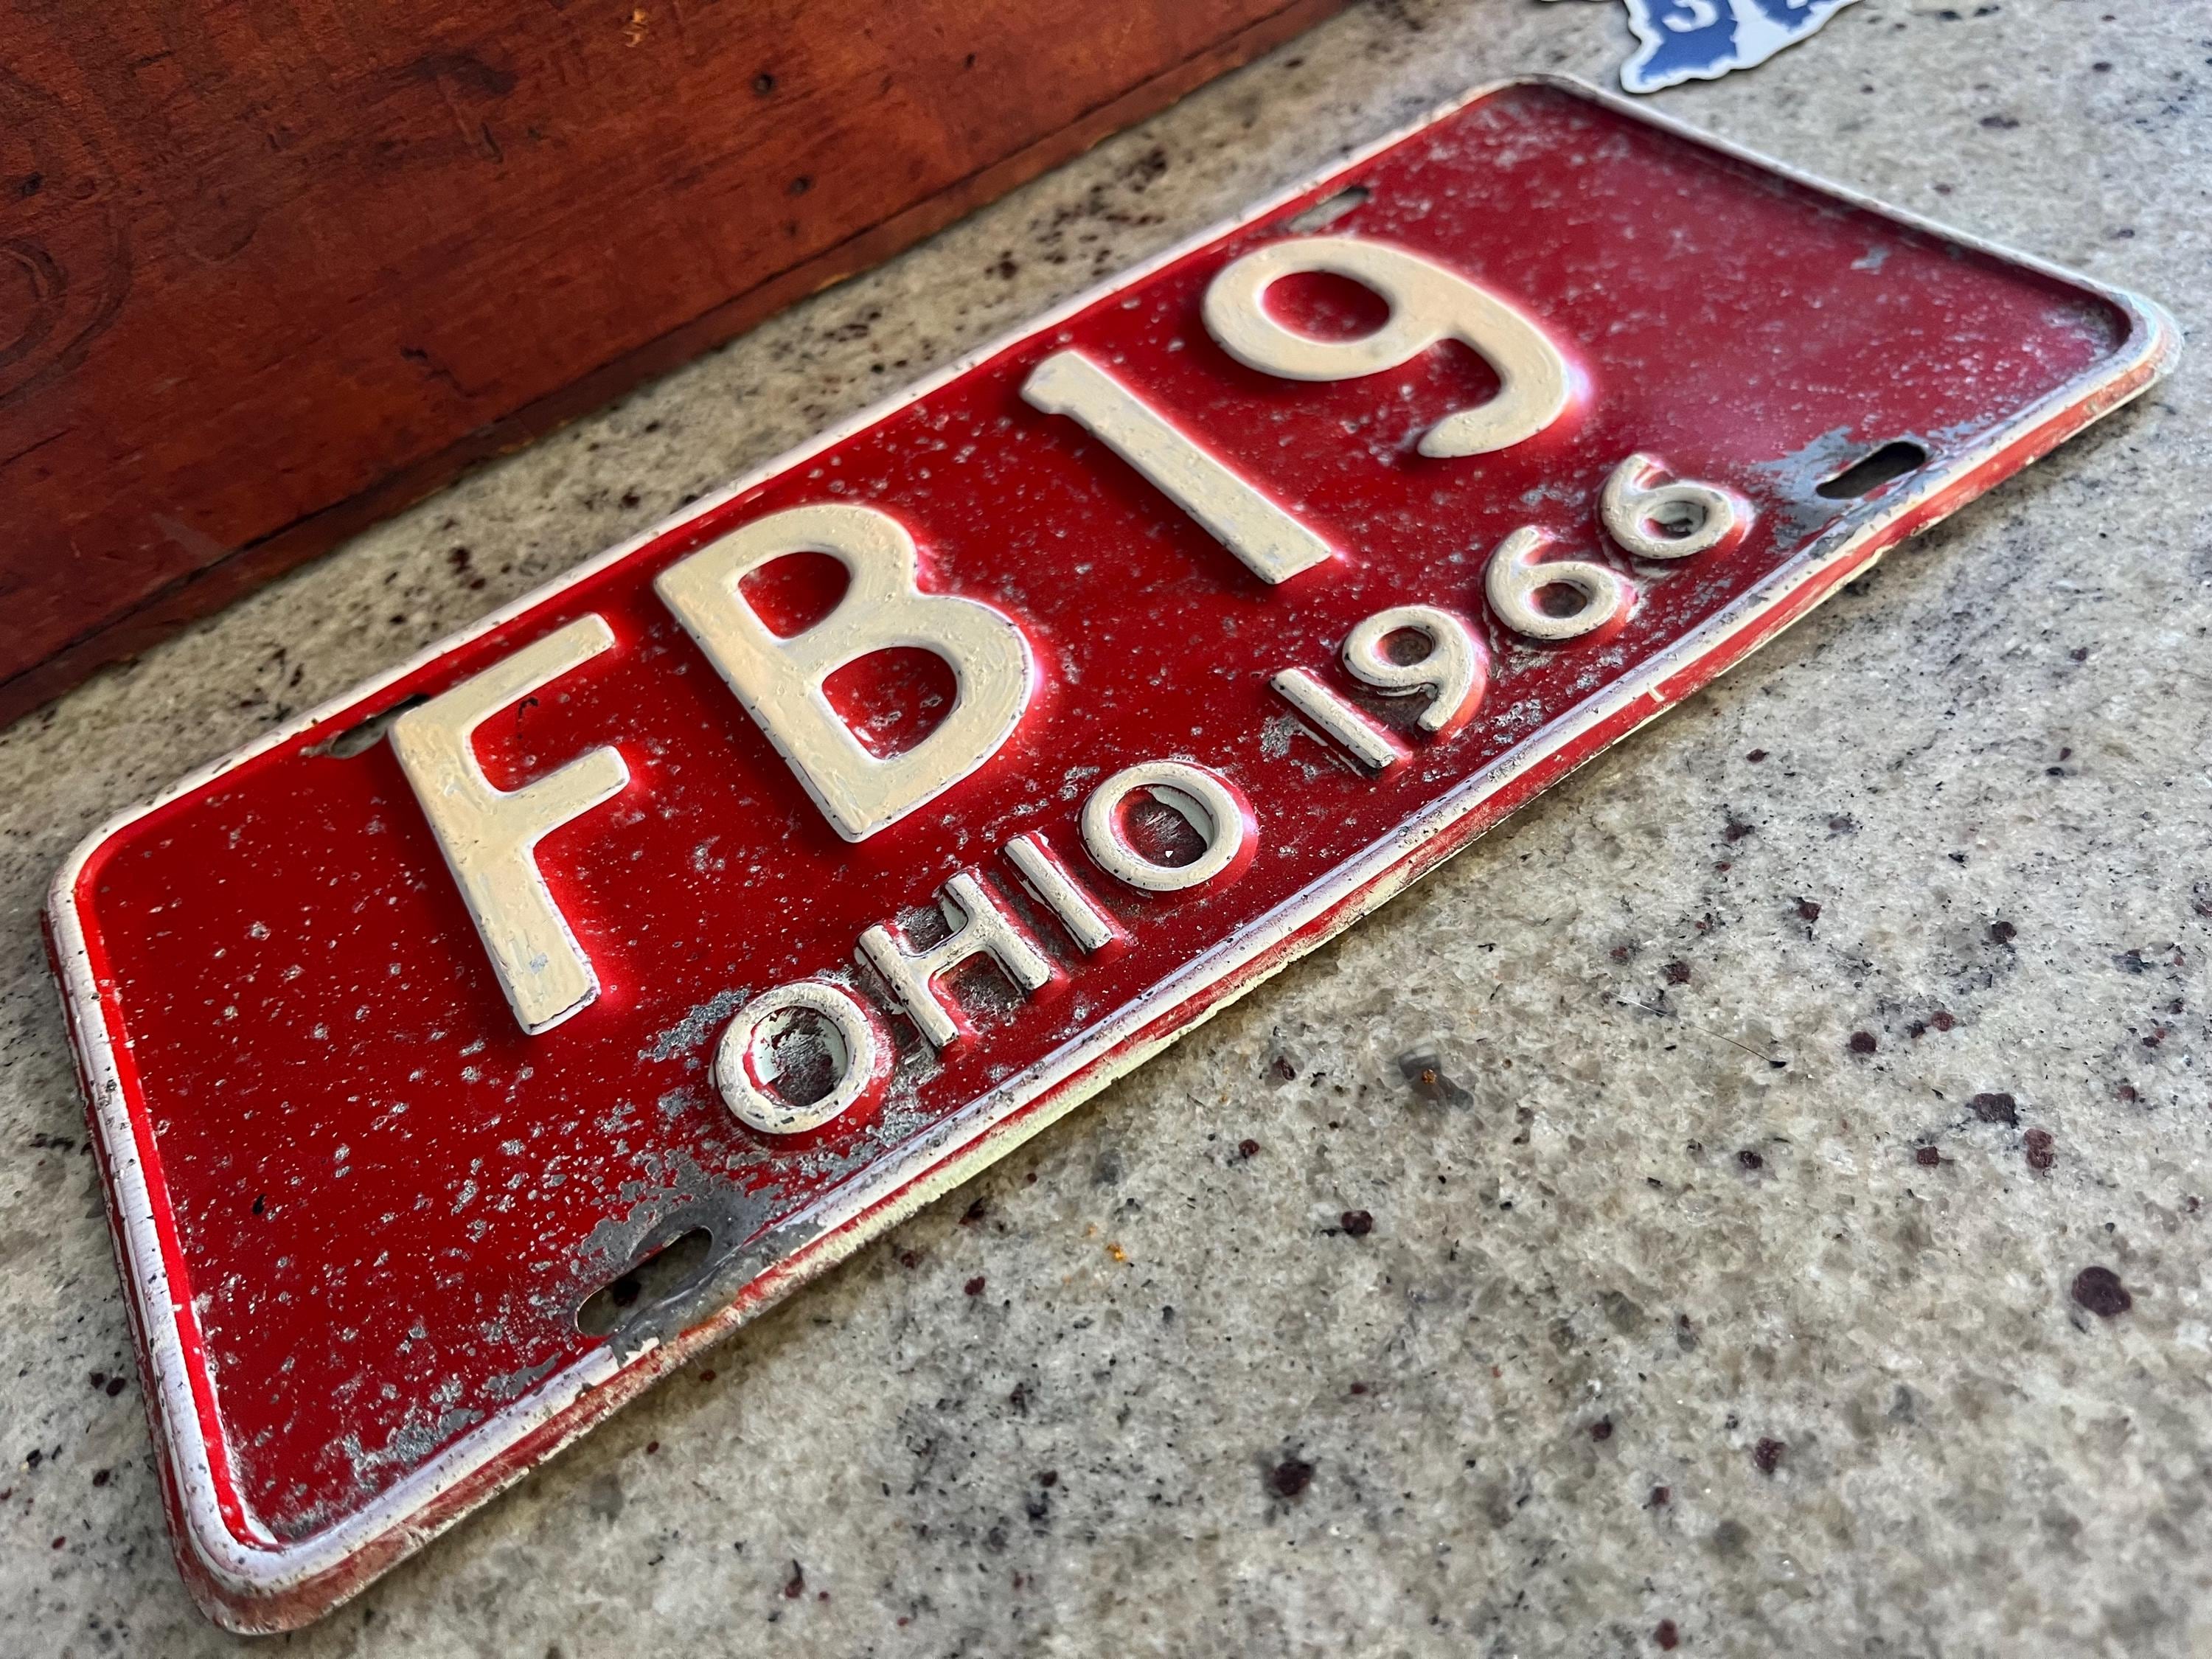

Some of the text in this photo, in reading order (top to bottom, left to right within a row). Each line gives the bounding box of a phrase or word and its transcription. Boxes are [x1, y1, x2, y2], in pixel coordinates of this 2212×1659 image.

[389, 237, 1569, 1035] FB 19
[714, 452, 1746, 1134] OHIO 1966
